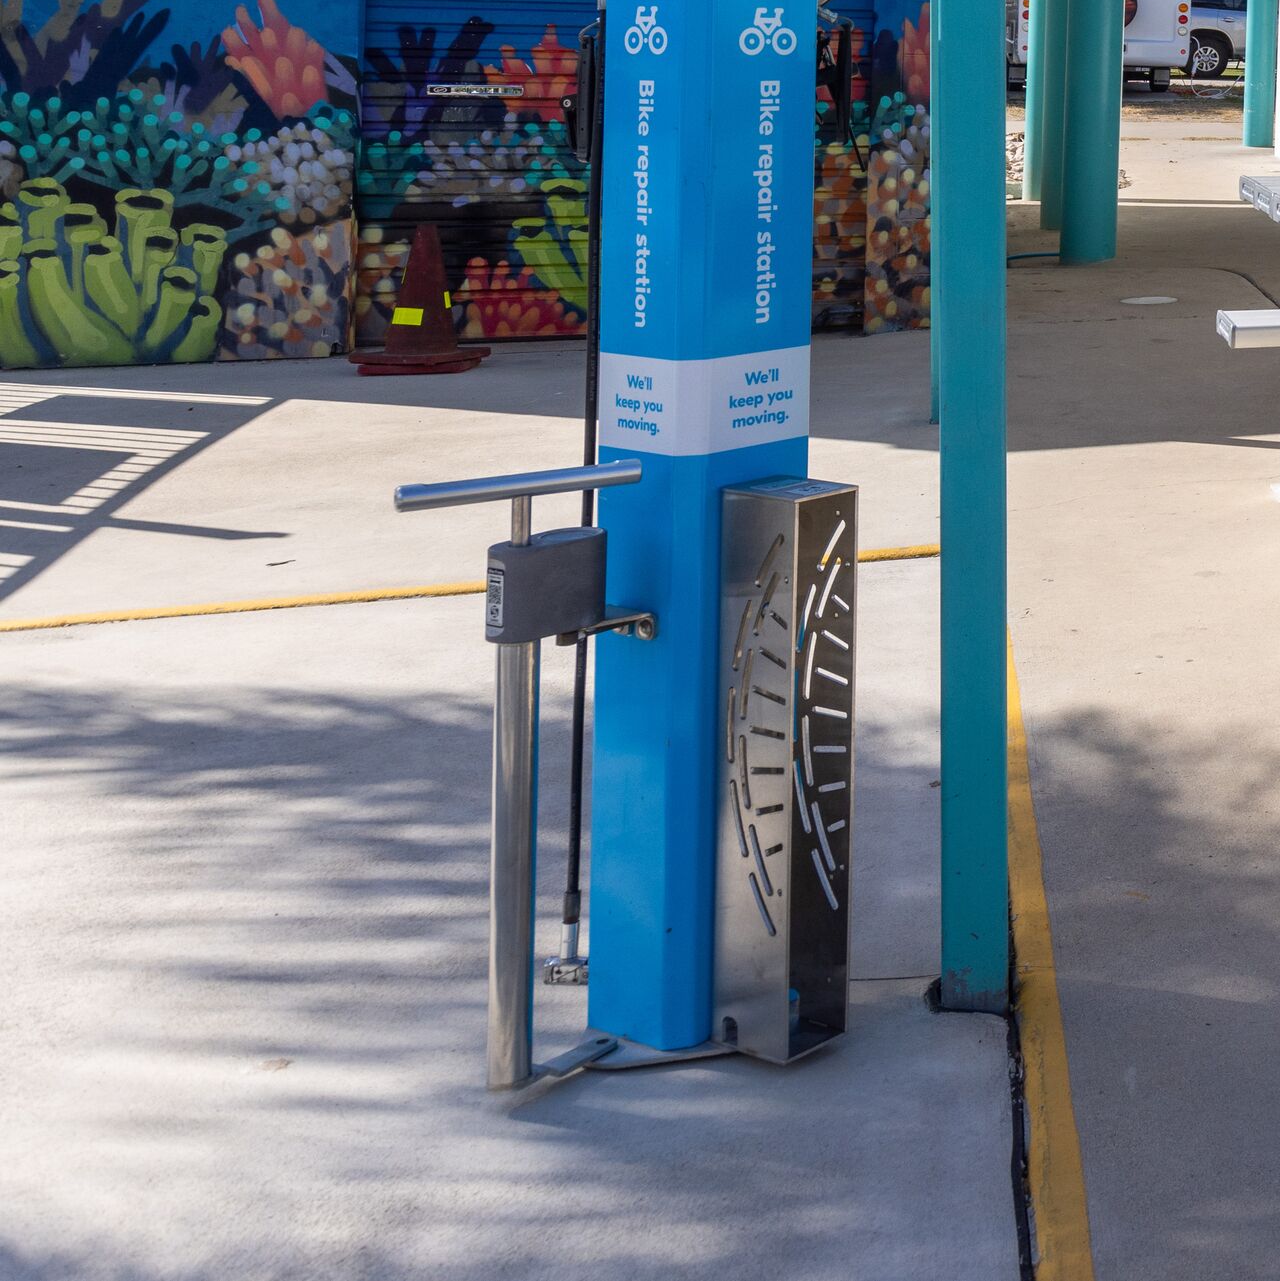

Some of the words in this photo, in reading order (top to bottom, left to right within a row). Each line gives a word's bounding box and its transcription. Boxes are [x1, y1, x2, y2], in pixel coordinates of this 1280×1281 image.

[638, 79, 655, 137] Bike
[758, 80, 780, 136] Bike
[633, 144, 653, 226] repair
[753, 144, 778, 223] repair
[634, 233, 651, 328] station
[755, 231, 776, 324] station
[626, 374, 652, 391] We'll
[744, 368, 779, 386] We'll
[615, 394, 641, 412] keep
[643, 401, 663, 413] you
[729, 393, 763, 409] keep
[767, 389, 793, 405] you
[617, 417, 660, 436] moving.
[732, 409, 789, 429] moving.
